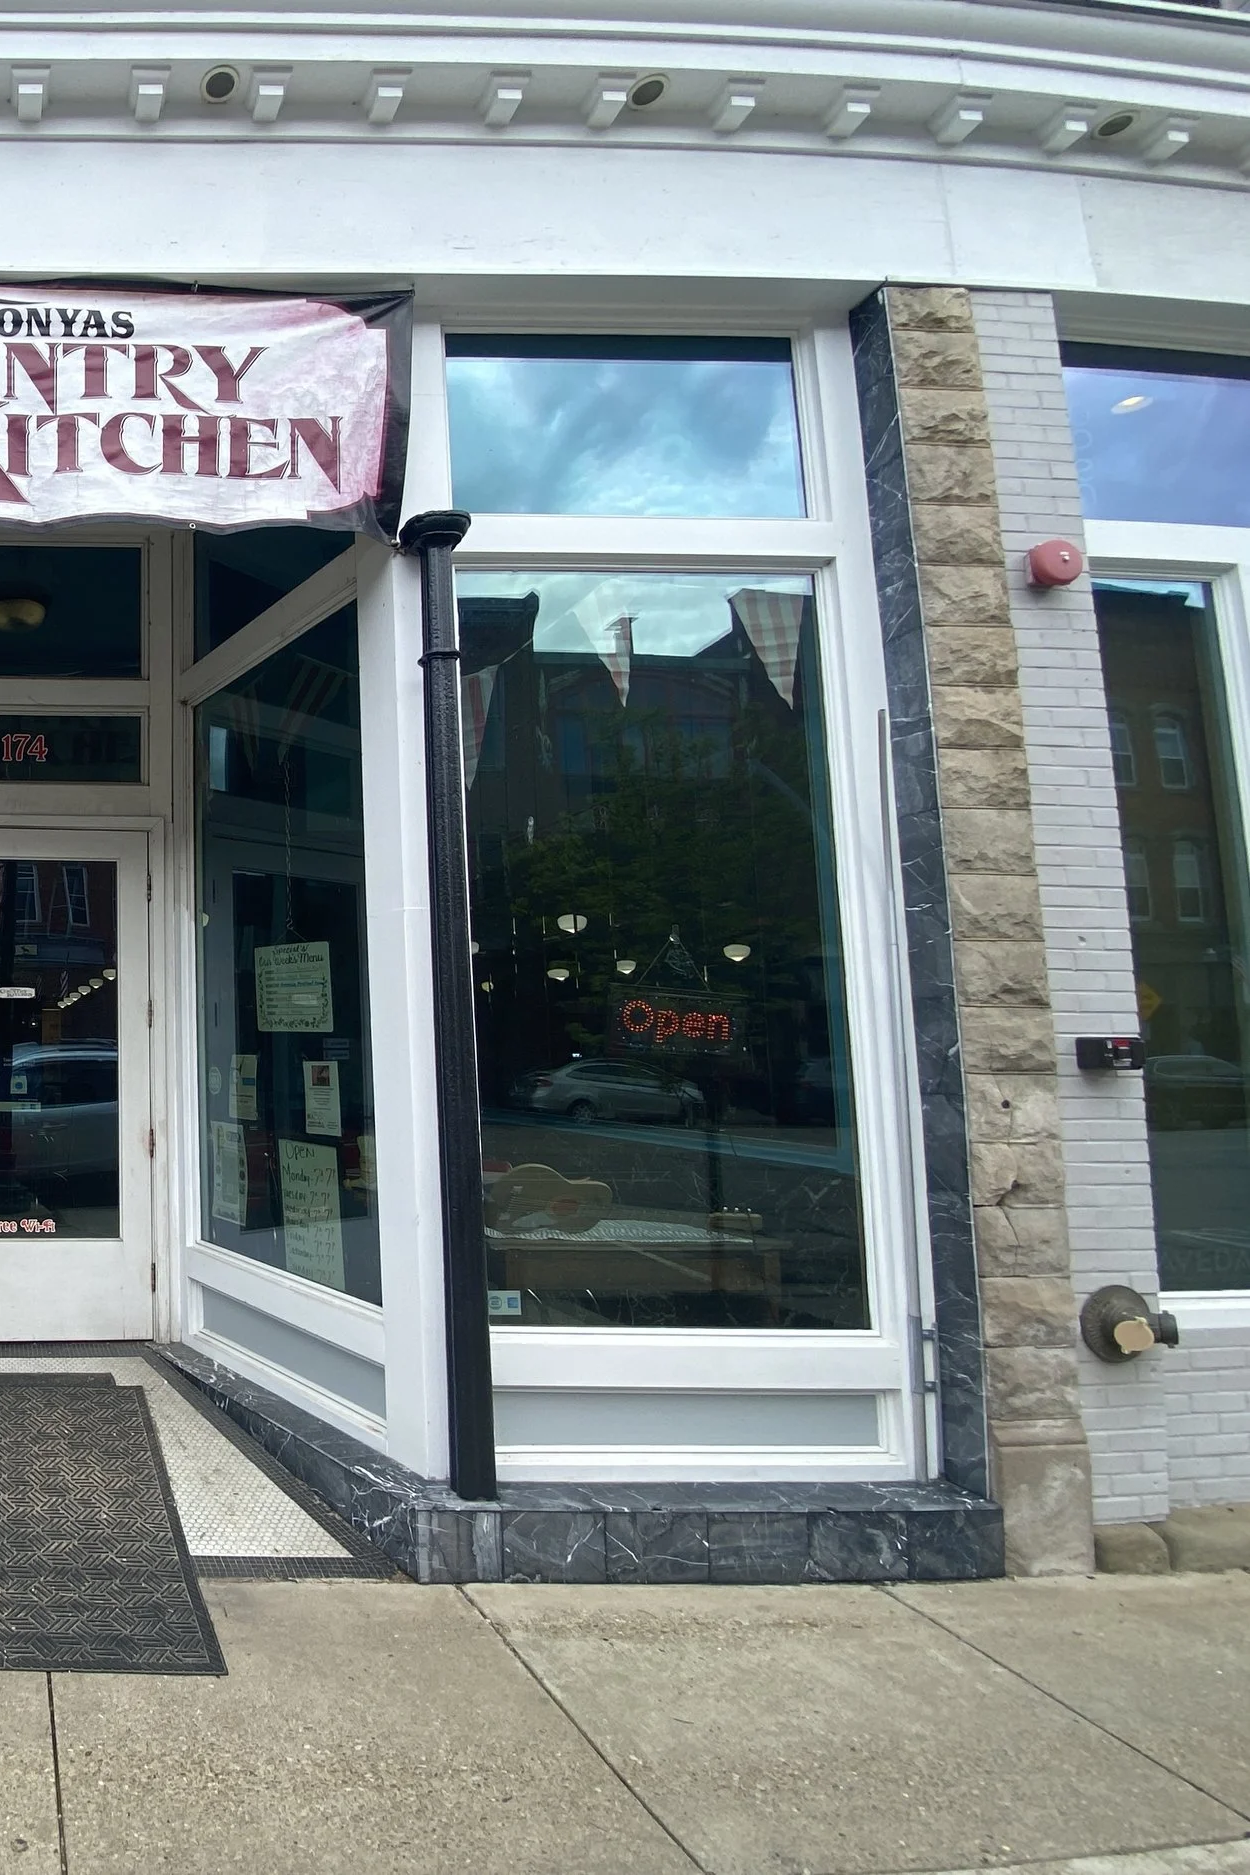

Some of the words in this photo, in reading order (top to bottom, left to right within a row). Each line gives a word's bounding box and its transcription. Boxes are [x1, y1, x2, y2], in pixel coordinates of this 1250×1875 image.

[1, 734, 48, 761] 174
[298, 953, 324, 964] Menu
[622, 1000, 730, 1042] Open
[20, 1219, 56, 1233] Wi-Fi
